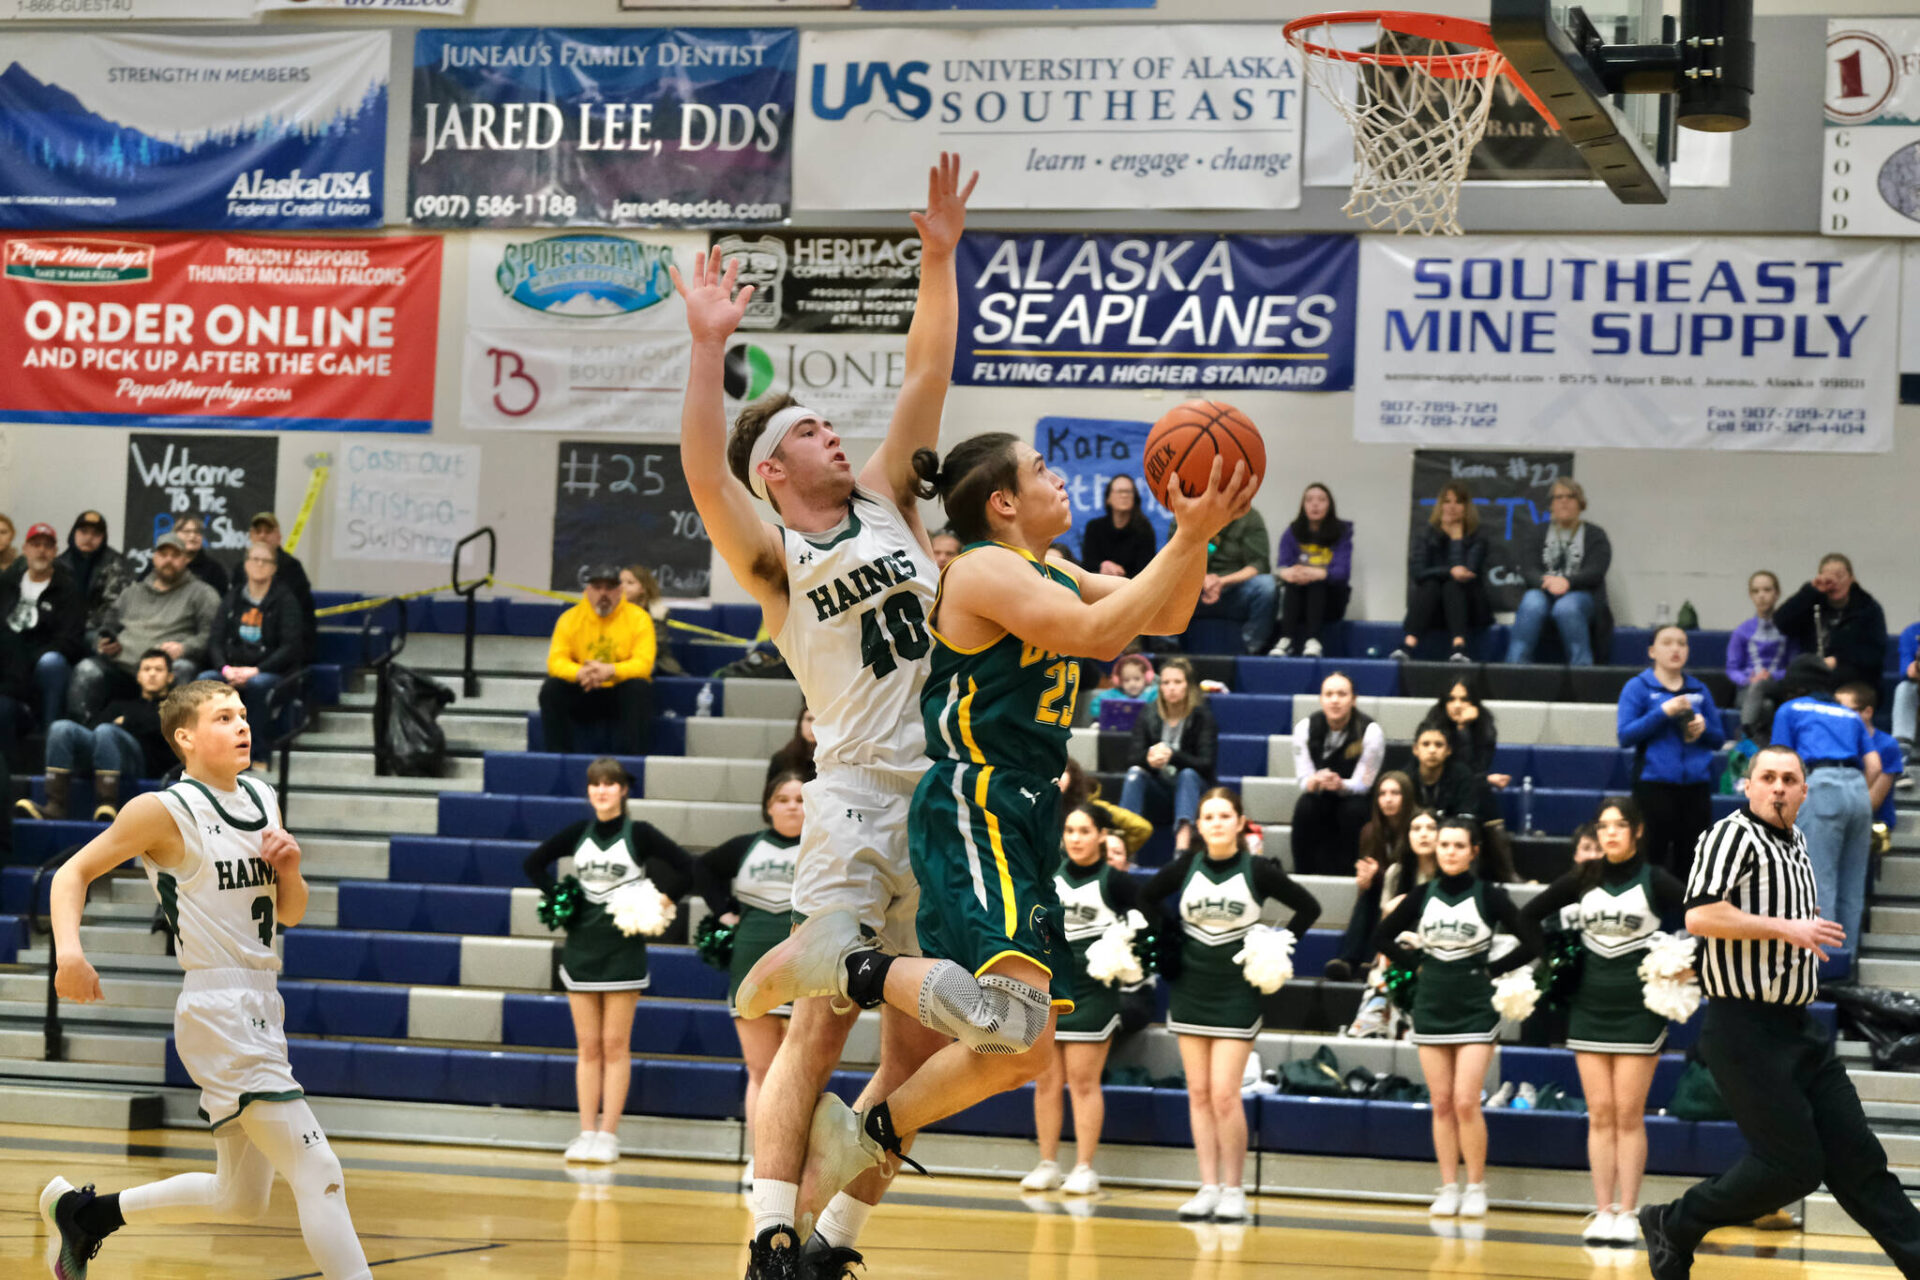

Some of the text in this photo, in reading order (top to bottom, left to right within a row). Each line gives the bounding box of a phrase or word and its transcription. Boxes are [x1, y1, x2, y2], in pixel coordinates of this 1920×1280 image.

[441, 42, 767, 72] JUNEAU'S FAMILY DENTIST
[943, 56, 1296, 82] UNIVERSITY OF ALASKA
[108, 67, 311, 83] STRENGTH IN MEMBERS
[810, 61, 933, 122] UAS
[940, 88, 1297, 123] SOUTHEAST
[419, 102, 780, 164] JARED LEE, DDS
[1026, 147, 1292, 177] learn engage change
[228, 201, 370, 216] Federal Credit Union
[414, 195, 781, 220] (907) 586-1188 jaredleedds.com
[10, 242, 147, 271] Papa Murphy's
[225, 248, 369, 266] PROUDLY SUPPORTS
[794, 238, 922, 266] HERITAG
[974, 239, 1235, 292] ALASKA
[188, 265, 407, 285] THUNDER MOUNTAIN FALCONS
[1413, 257, 1844, 305] SOUTHEAST
[24, 299, 395, 348] ORDER ONLINE
[972, 292, 1337, 348] SEAPLANES
[1383, 309, 1869, 358] MINE SUPPLY
[23, 347, 391, 376] AND PICK UP AFTER THE GAME
[788, 344, 905, 394] JONE
[973, 362, 1327, 384] FLYING AT A HIGHER STANDARD
[130, 441, 246, 488] Welcome
[164, 487, 191, 513] To
[806, 549, 917, 622] HAINES
[860, 590, 933, 680] 40
[1035, 660, 1080, 729] 23
